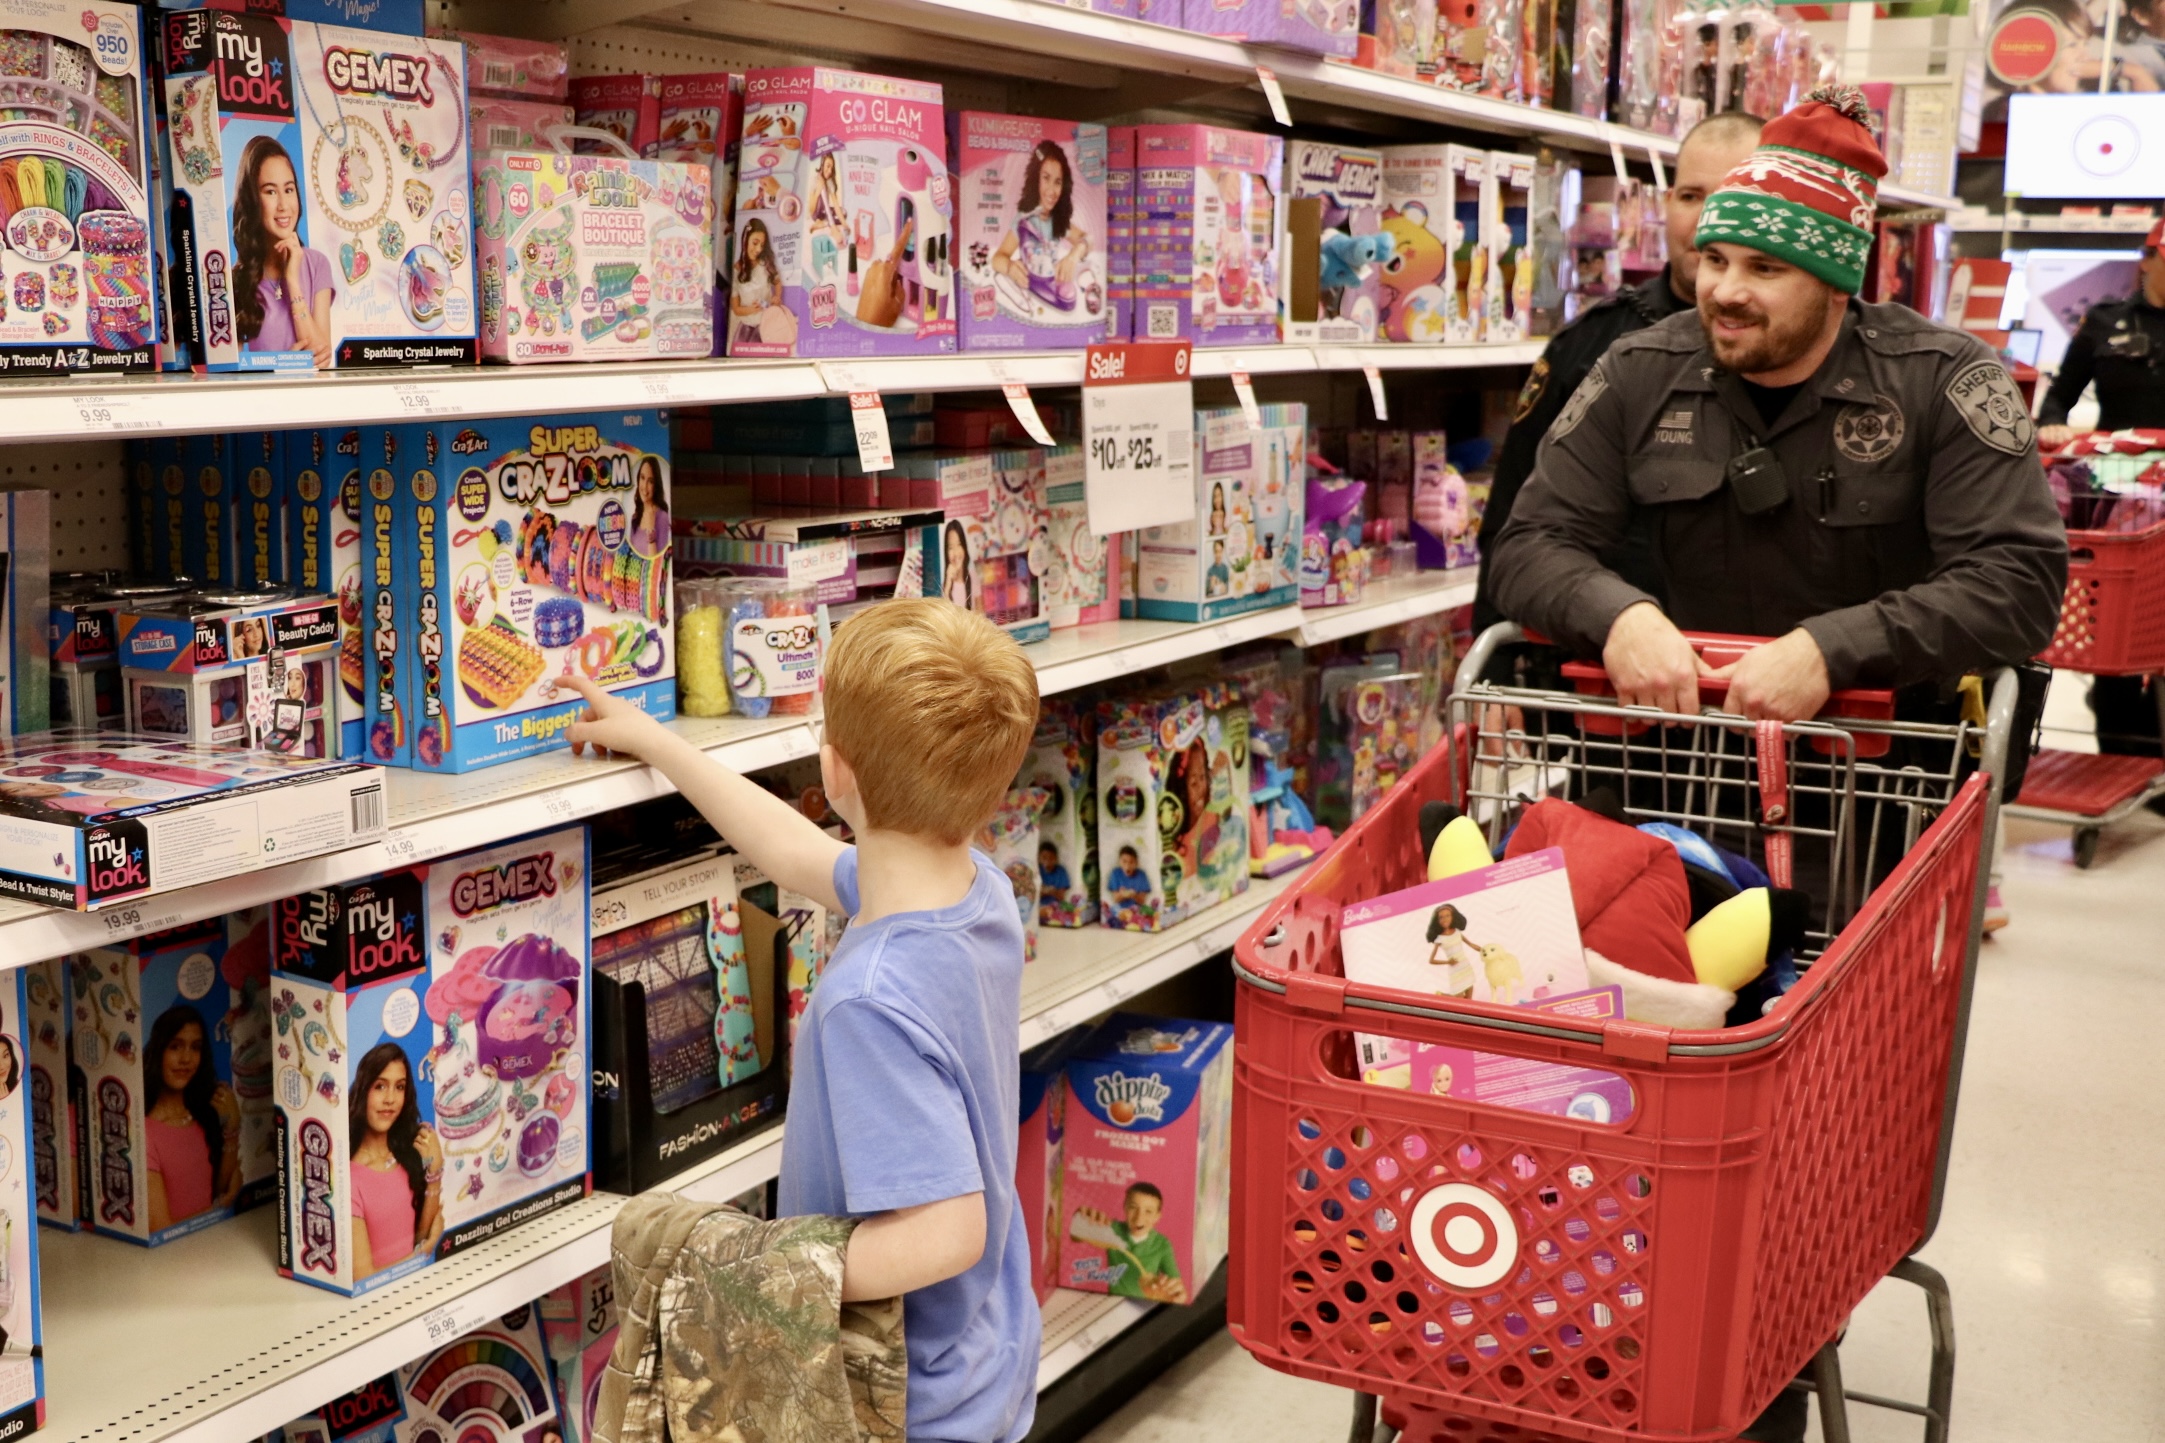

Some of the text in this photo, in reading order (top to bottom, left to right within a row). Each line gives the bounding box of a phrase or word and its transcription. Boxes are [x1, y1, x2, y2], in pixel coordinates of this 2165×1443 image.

[183, 13, 202, 49] my
[97, 35, 128, 54] 950
[169, 15, 191, 70] look
[102, 55, 127, 65] Beads!
[216, 32, 263, 77] my
[218, 58, 290, 109] look
[326, 50, 432, 101] GEMEX
[749, 77, 811, 92] GO GLAM
[604, 84, 640, 95] GLAM
[665, 82, 725, 97] GO GLAM
[840, 100, 923, 132] GO GLAM
[880, 124, 895, 135] NAIL
[899, 127, 920, 140] SALON
[12, 132, 31, 143] with
[33, 132, 66, 148] RINGS
[76, 145, 132, 195] BRACELETS!
[508, 160, 524, 168] ONLY
[1300, 149, 1378, 193] CARE BEARS
[573, 167, 652, 199] Rainbow
[1142, 170, 1191, 179] MIX & MATCH
[509, 191, 527, 208] 60
[589, 184, 639, 207] Loom
[583, 213, 645, 229] BRACELET
[583, 229, 645, 244] BOUTIQUE
[773, 232, 800, 243] Instant
[182, 229, 192, 273] Sparkling
[190, 308, 199, 343] Jewelry
[99, 296, 141, 307] HAPPY
[206, 250, 231, 346] GEMEX
[12, 354, 52, 368] Trendy
[92, 352, 132, 367] Jewelry
[135, 352, 149, 363] Kit
[251, 357, 277, 366] WARNING:
[364, 346, 464, 359] Sparkling Crystal Jewelry
[1090, 352, 1125, 379] Sale!
[1834, 378, 1855, 394] K9
[1955, 367, 2003, 398] SHERIFF
[400, 395, 430, 407] 12.99
[850, 395, 874, 408] Sale!
[80, 409, 112, 422] 9.99
[623, 415, 643, 426] NEW!
[530, 425, 601, 457] SUPER
[1654, 430, 1694, 445] YOUNG
[1091, 437, 1116, 471] $10
[1128, 437, 1153, 470] $25
[461, 484, 486, 495] SUPER
[464, 495, 484, 506] WIDE
[463, 506, 486, 515] Projects!
[203, 501, 220, 581] SUPER
[302, 506, 318, 588] SUPER
[374, 504, 391, 586] SUPER
[417, 505, 436, 590] SUPER
[792, 554, 819, 571] make
[510, 597, 533, 607] 6-Row
[511, 589, 532, 597] Amazing
[512, 607, 532, 615] Bracelet
[514, 614, 530, 623] Loom!
[77, 620, 100, 638] my
[196, 629, 215, 647] my
[278, 622, 335, 641] Beauty Caddy
[134, 638, 173, 650] STORAGE CASE
[196, 641, 226, 660] look
[777, 651, 813, 663] Ultimate
[494, 722, 518, 744] The
[522, 712, 576, 740] Biggest
[545, 800, 572, 815] 19.99
[20, 828, 59, 842] PERSONALIZE
[89, 837, 127, 867] my
[385, 841, 414, 857] 14.99
[91, 855, 146, 892] look
[27, 884, 48, 897] Twist
[50, 888, 74, 901] Styler
[453, 856, 555, 912] GEMEX
[643, 888, 661, 902] TELL
[662, 878, 688, 895] YOUR
[688, 868, 719, 887] STORY!
[104, 910, 141, 929] 19.99
[349, 898, 394, 941] my
[1343, 907, 1374, 925] Barbie
[350, 923, 422, 976] look
[503, 1056, 533, 1069] GEMEX
[1095, 1128, 1140, 1143] FROZEN
[102, 1080, 132, 1223] GEMEX
[277, 1128, 285, 1169] Dazzling
[302, 1123, 335, 1271] GEMEX
[455, 1184, 582, 1246] Dazzling Gel Creations Studio
[428, 1317, 456, 1339] 29.99
[329, 1380, 395, 1429] look
